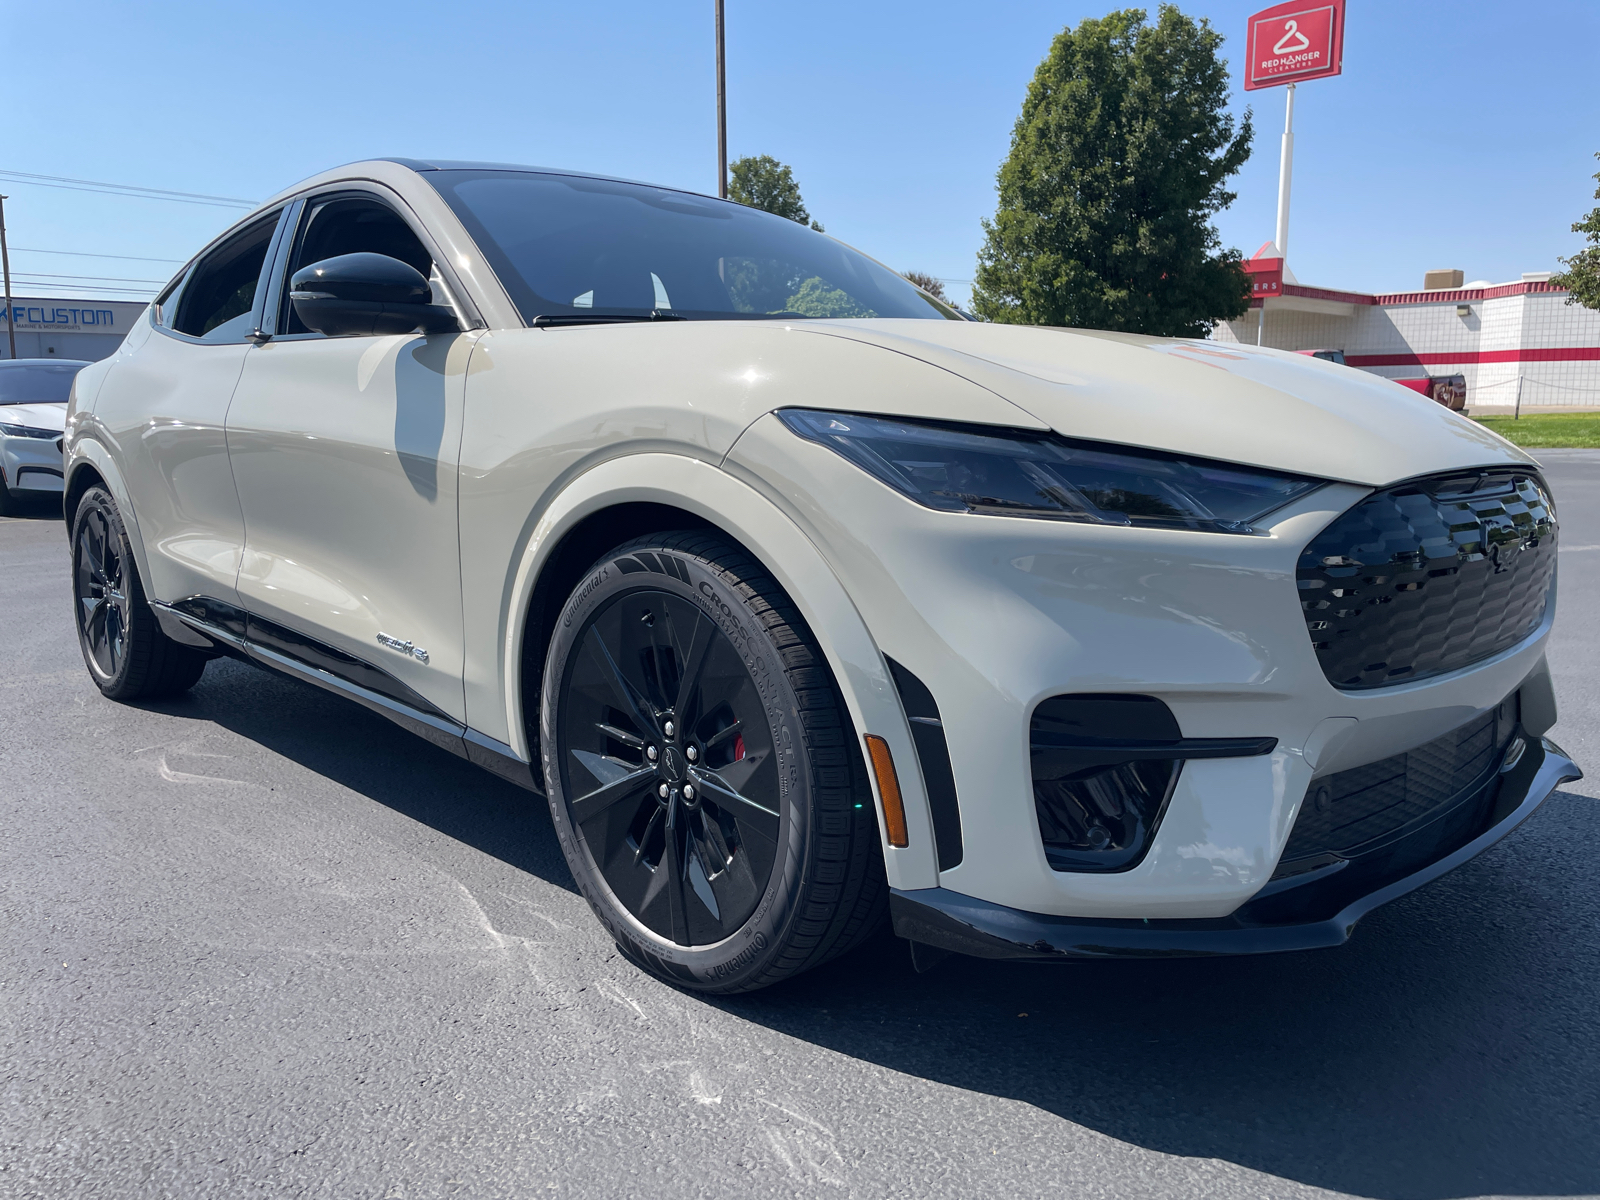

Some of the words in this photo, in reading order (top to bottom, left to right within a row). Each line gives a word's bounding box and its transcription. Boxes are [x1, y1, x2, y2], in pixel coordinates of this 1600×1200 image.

[1262, 59, 1279, 69] RED
[1280, 51, 1320, 65] HANGER
[1269, 61, 1312, 73] CLEANERS
[564, 570, 603, 628] Continental
[712, 931, 768, 980] Continental
